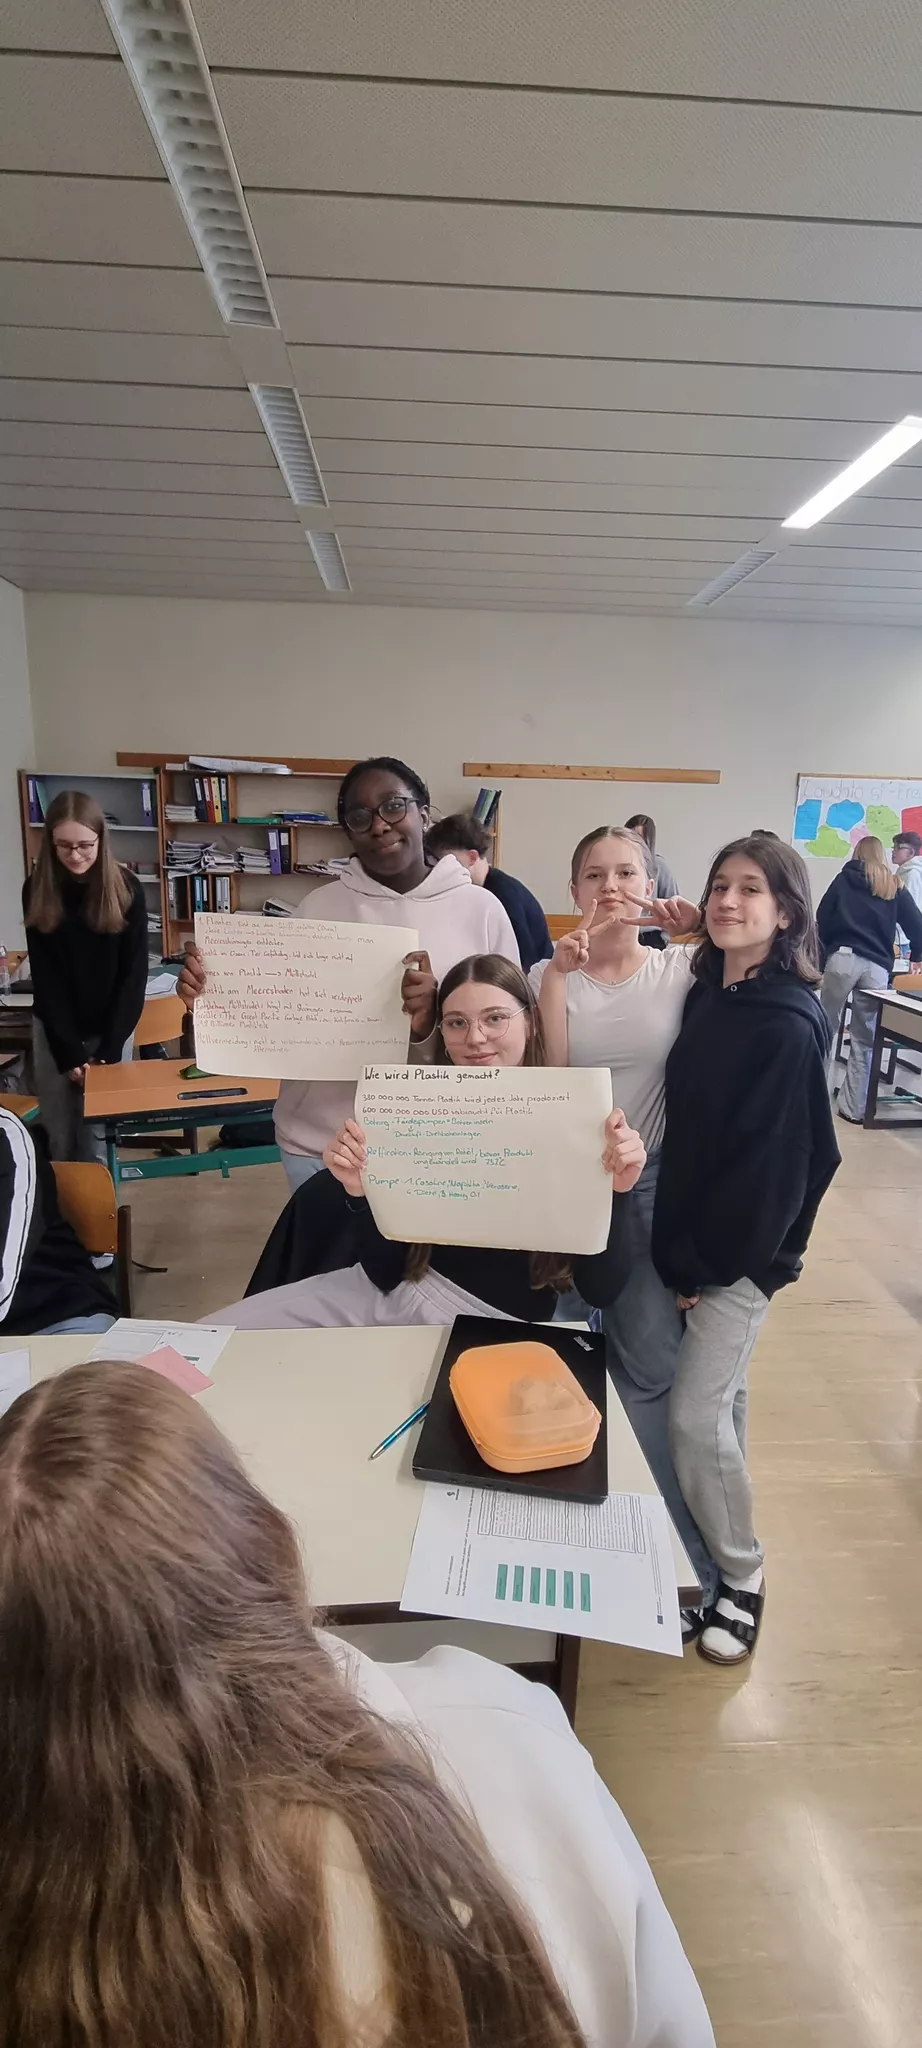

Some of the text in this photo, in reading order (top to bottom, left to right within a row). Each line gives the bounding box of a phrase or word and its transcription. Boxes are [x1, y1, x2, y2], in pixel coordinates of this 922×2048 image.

[364, 1067, 501, 1084] Wie wird Plastik gemacht?
[412, 1095, 436, 1103] Tonnen
[437, 1094, 461, 1103] Plastik
[464, 1095, 482, 1103] wird
[482, 1095, 506, 1105] jedes
[362, 1106, 377, 1114] 600
[431, 1108, 449, 1116] USD
[505, 1106, 533, 1115] Plastik
[368, 1174, 400, 1189] Pumpe
